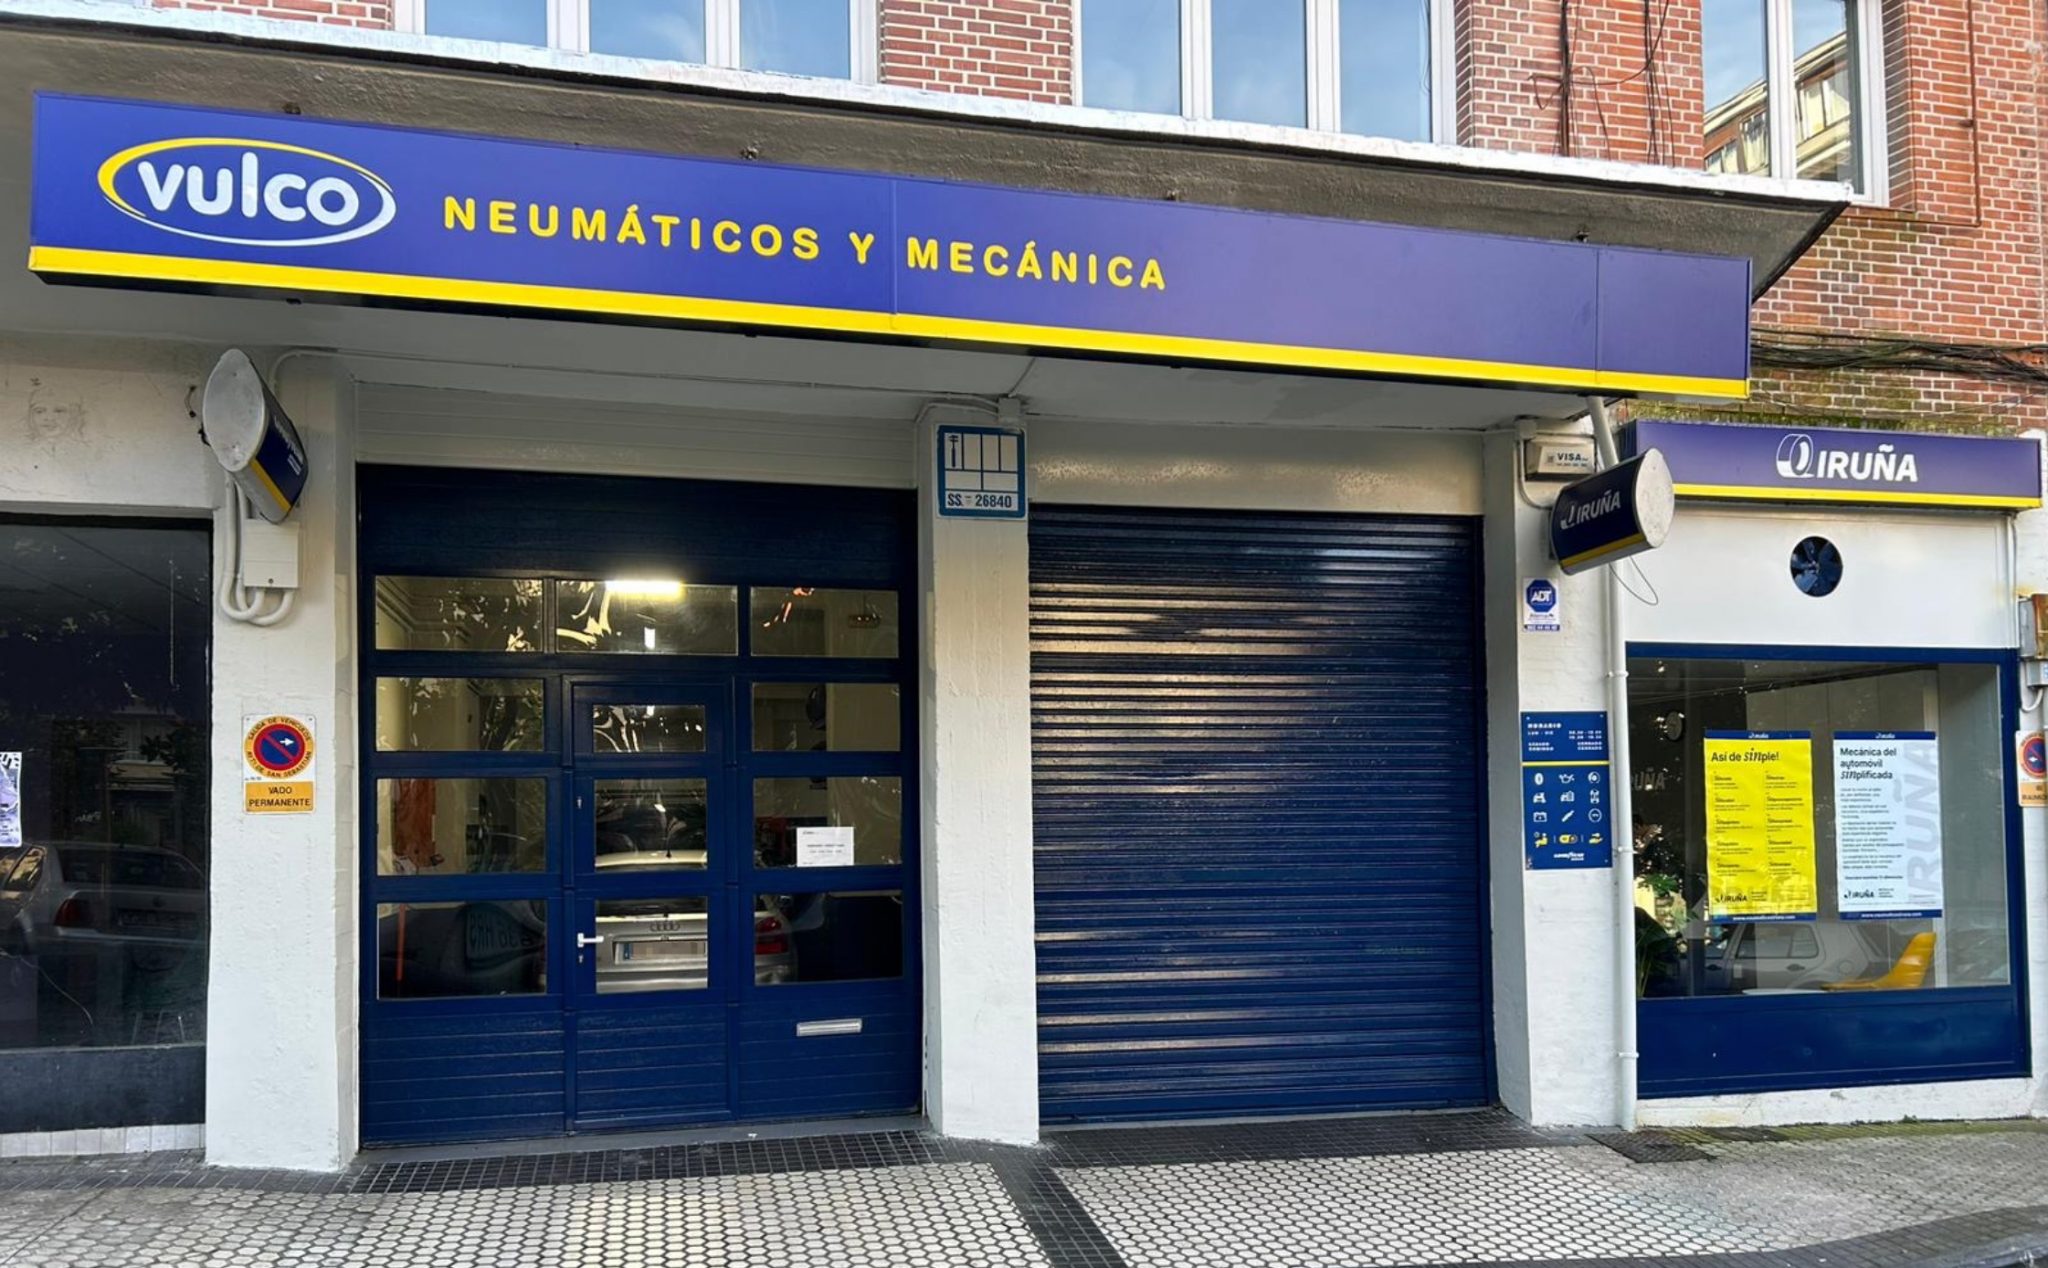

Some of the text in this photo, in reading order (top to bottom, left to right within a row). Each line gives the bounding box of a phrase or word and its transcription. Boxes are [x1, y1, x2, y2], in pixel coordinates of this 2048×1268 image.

[138, 151, 360, 227] vulco
[443, 195, 1168, 292] NEUMÁTICOS Y MECÁNICA
[1815, 443, 1919, 484] IRUÑA
[975, 494, 1013, 509] 26840
[1576, 488, 1621, 525] IRUÑA
[1531, 590, 1552, 602] ADT
[1729, 751, 1741, 762] de
[1840, 747, 1897, 757] Mecánica del
[1840, 758, 1883, 768] automóvil
[268, 786, 293, 795] VADO
[248, 798, 312, 807] PERMANENTE
